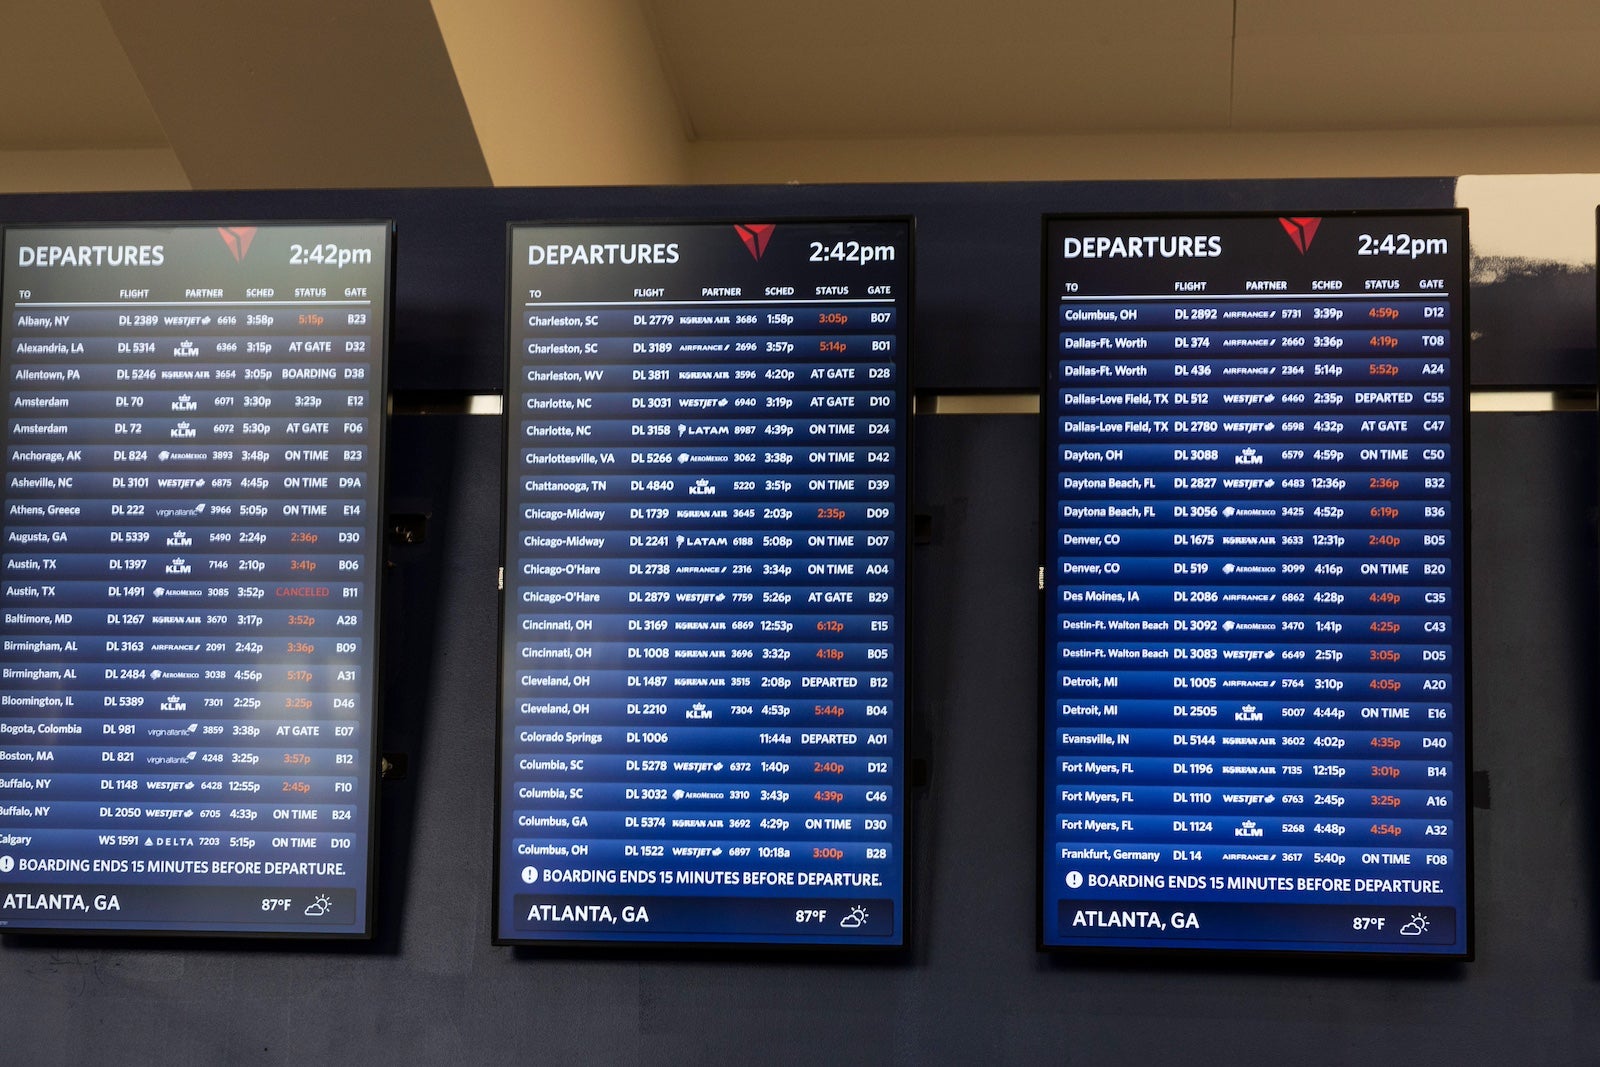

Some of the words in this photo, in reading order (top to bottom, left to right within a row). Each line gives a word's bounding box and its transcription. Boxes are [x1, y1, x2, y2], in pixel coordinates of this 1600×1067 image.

[528, 243, 680, 265] DEPARTURES
[809, 241, 895, 266] 2:42pm
[1064, 235, 1222, 259] DEPARTURES
[1357, 233, 1448, 260] 2:42pm
[19, 245, 164, 267] DEPARTURES
[289, 243, 372, 269] 2:42pm
[19, 290, 32, 299] TO
[119, 289, 149, 299] FLIGHT
[185, 288, 224, 298] PARTNER
[246, 288, 275, 298] SCHED
[294, 287, 327, 298] STATUS
[344, 287, 367, 298] GATE
[529, 289, 542, 299] TO
[633, 288, 665, 298] FLIGHT
[702, 287, 742, 297] PARTNER
[765, 286, 795, 296] SCHED
[815, 286, 849, 295] STATUS
[867, 285, 891, 295] GATE
[1065, 282, 1079, 293] TO
[1174, 281, 1207, 292] FLIGHT
[1246, 280, 1288, 291] PARTNER
[1311, 280, 1343, 291] SCHED
[1365, 279, 1400, 290] STATUS
[1419, 279, 1444, 290] GATE
[17, 315, 53, 329] Albany,
[54, 315, 70, 327] NY
[119, 315, 133, 327] DL
[133, 315, 159, 326] 2389
[164, 316, 203, 327] WESTJET
[217, 316, 237, 325] 6616
[246, 314, 274, 327] 3:58p
[298, 314, 324, 326] 5:15p
[347, 313, 367, 325] B23
[14, 396, 69, 408] Amsterdam
[115, 396, 130, 408] DL
[130, 396, 144, 408] 70
[171, 399, 198, 411] KLM
[214, 396, 234, 406] 6071
[243, 396, 272, 409] 3:30p
[295, 395, 322, 408] 3:23p
[347, 395, 364, 407] E12
[1064, 393, 1124, 405] Dallas-Love
[1124, 393, 1152, 406] Field,
[1153, 393, 1169, 405] TX
[1174, 393, 1189, 405] DL
[1190, 393, 1209, 405] 512
[1223, 394, 1266, 406] WESTJET
[1281, 393, 1305, 403] 6460
[1313, 392, 1344, 406] 2:35p
[1355, 392, 1414, 404] DEPARTED
[1423, 392, 1445, 404] C55
[526, 425, 575, 438] Charlotte,
[575, 425, 592, 436] NC
[631, 424, 646, 436] DL
[646, 424, 671, 436] 3158
[688, 426, 730, 435] LATAM
[734, 425, 757, 435] 8987
[764, 424, 794, 437] 4:39p
[809, 424, 827, 435] ON
[827, 424, 856, 435] TIME
[868, 424, 890, 435] D24
[11, 477, 56, 489] Asheville,
[57, 477, 73, 488] NC
[112, 477, 126, 489] DL
[127, 477, 149, 489] 3101
[157, 479, 198, 490] WESTJET
[211, 478, 232, 487] 6875
[240, 477, 270, 490] 4:45p
[283, 477, 300, 488] ON
[301, 477, 329, 488] TIME
[339, 477, 362, 488] D9A
[524, 535, 605, 549] Chicago-Midway
[629, 535, 644, 547] DL
[645, 535, 669, 547] 2241
[686, 537, 728, 547] LATAM
[732, 537, 754, 547] 6188
[762, 536, 793, 549] 5:08p
[808, 535, 825, 547] ON
[826, 536, 855, 547] TIME
[867, 536, 890, 547] D07
[7, 559, 41, 571] Austin,
[42, 559, 57, 569] TX
[109, 559, 124, 570] DL
[124, 559, 148, 570] 1397
[165, 563, 192, 574] KLM
[209, 560, 229, 569] 7146
[238, 559, 266, 572] 2:10p
[290, 560, 317, 572] 3:41p
[339, 560, 360, 570] B06
[520, 703, 571, 716] Cleveland,
[572, 703, 590, 714] OH
[627, 703, 642, 715] DL
[642, 703, 668, 715] 2210
[685, 708, 713, 719] KLM
[730, 705, 754, 715] 7304
[761, 704, 791, 718] 4:53p
[814, 705, 845, 718] 5:44p
[866, 705, 888, 716] B04
[1062, 704, 1102, 717] Detroit,
[1103, 705, 1118, 716] MI
[1173, 705, 1189, 716] DL
[1189, 705, 1218, 717] 2505
[1234, 710, 1263, 721] KLM
[1282, 708, 1306, 717] 5007
[1313, 707, 1346, 720] 4:44p
[1361, 707, 1379, 719] ON
[1380, 707, 1410, 719] TIME
[1428, 708, 1447, 719] E16
[519, 731, 565, 743] Colorado
[565, 731, 603, 745] Springs
[626, 732, 641, 743] DL
[641, 732, 669, 744] 1006
[759, 733, 792, 744] 11:44a
[801, 733, 858, 745] DEPARTED
[867, 733, 887, 745] A01
[1061, 790, 1083, 802] Fort
[1084, 791, 1120, 804] Myers,
[1121, 791, 1134, 803] FL
[1173, 792, 1189, 803] DL
[1189, 792, 1212, 804] 1110
[1222, 794, 1266, 806] WESTJET
[1281, 794, 1304, 804] 6763
[1314, 794, 1346, 807] 2:45p
[1371, 795, 1401, 808] 3:25p
[1426, 796, 1448, 807] A16
[19, 858, 90, 872] BOARDING
[93, 859, 129, 873] ENDS
[131, 860, 145, 873] 15
[147, 860, 209, 874] MINUTES
[211, 861, 262, 874] BEFORE
[264, 862, 346, 876] DEPARTURE.
[543, 869, 617, 884] BOARDING
[619, 870, 657, 884] ENDS
[659, 871, 674, 884] 15
[676, 870, 740, 885] MINUTES
[742, 871, 795, 886] BEFORE
[797, 872, 883, 887] DEPARTURE.
[1088, 874, 1165, 889] BOARDING
[1168, 875, 1207, 890] ENDS
[1209, 876, 1225, 890] 15
[1227, 876, 1294, 891] MINUTES
[1297, 877, 1352, 892] BEFORE
[1354, 878, 1444, 894] DEPARTURE.
[2, 893, 90, 913] ATLANTA,
[93, 895, 121, 911] GA
[527, 904, 618, 925] ATLANTA,
[621, 906, 650, 923] GA
[1072, 910, 1167, 932] ATLANTA,
[1170, 912, 1200, 929] GA
